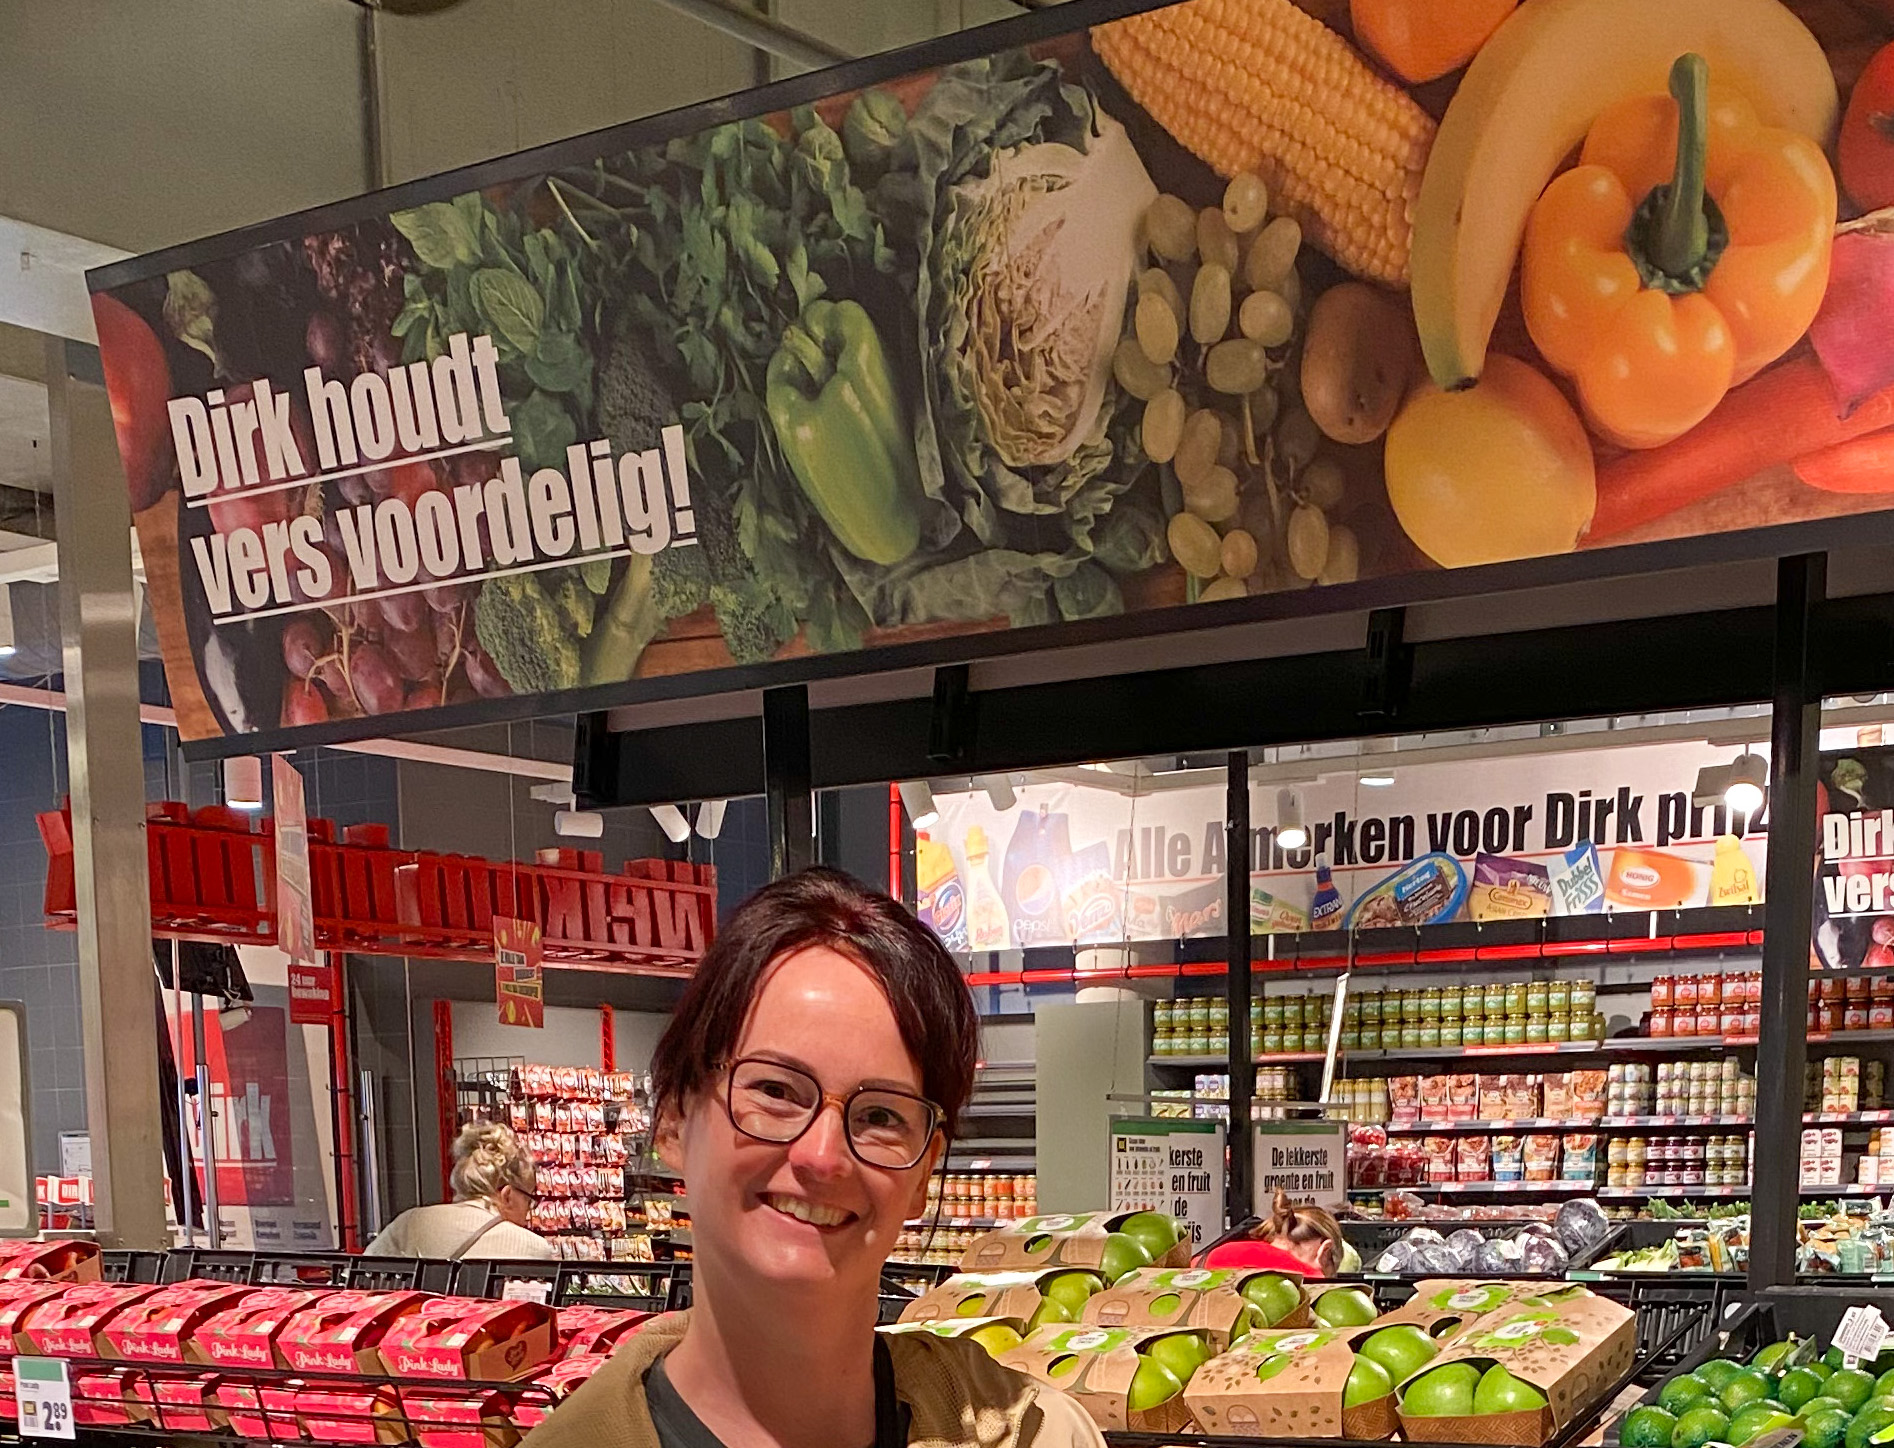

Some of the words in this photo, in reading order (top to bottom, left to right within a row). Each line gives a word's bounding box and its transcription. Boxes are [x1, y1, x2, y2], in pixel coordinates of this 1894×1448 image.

[167, 379, 308, 498] Dirk
[305, 334, 511, 471] houdt
[191, 513, 332, 614] vers
[337, 424, 696, 590] voordelig!
[1113, 826, 1191, 881] Alle
[1427, 804, 1533, 855] voor
[1545, 787, 1643, 849] Dirk
[1626, 871, 1654, 882] HONIG
[1719, 880, 1750, 898] Zwitsal
[1823, 873, 1894, 913] ver
[1313, 897, 1343, 918] EXTRAN
[1272, 1147, 1284, 1166] De
[1286, 1147, 1327, 1166] lekkerste
[1172, 1173, 1184, 1191] en
[1188, 1171, 1210, 1191] fruit
[1264, 1173, 1299, 1193] groente
[1302, 1174, 1313, 1189] en
[1316, 1171, 1333, 1189] fruit
[62, 1184, 79, 1199] DIR
[1175, 1197, 1187, 1216] de
[41, 1338, 67, 1353] Pink
[69, 1338, 92, 1354] Lady
[121, 1339, 148, 1355] Pink
[150, 1340, 178, 1358] Lady
[211, 1342, 238, 1359] Pink
[239, 1344, 268, 1362] Lady
[295, 1351, 322, 1368] Pink
[323, 1353, 353, 1371] Lady
[398, 1356, 428, 1373] Pink
[428, 1357, 460, 1376] Lady
